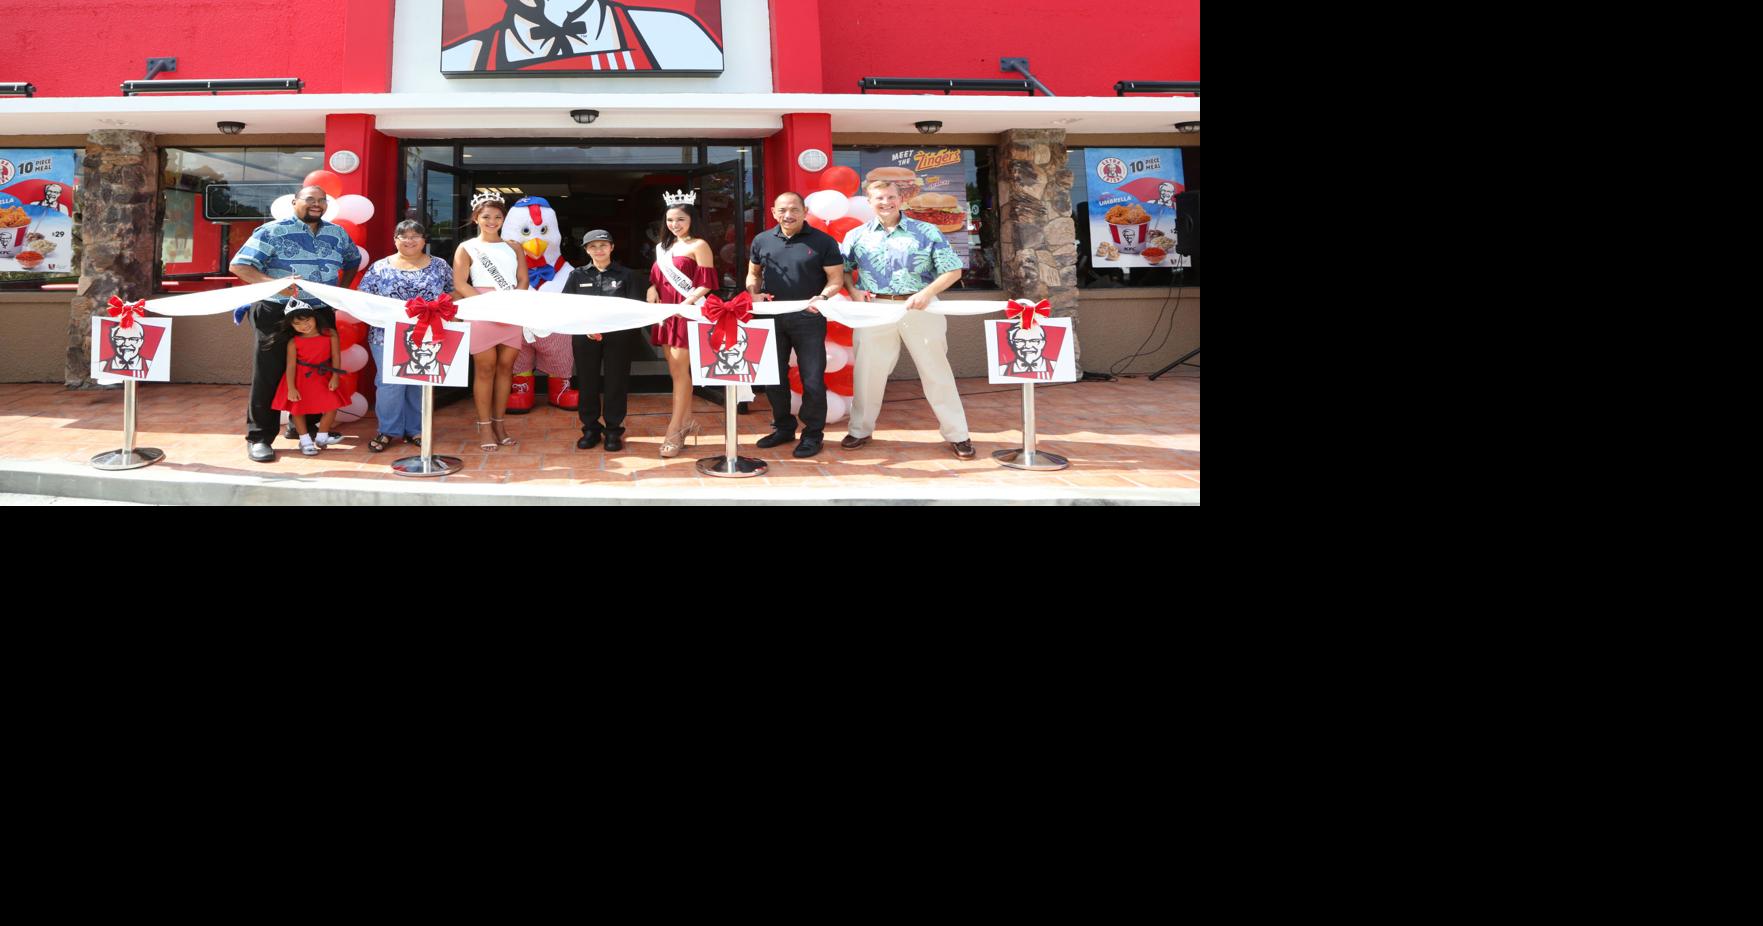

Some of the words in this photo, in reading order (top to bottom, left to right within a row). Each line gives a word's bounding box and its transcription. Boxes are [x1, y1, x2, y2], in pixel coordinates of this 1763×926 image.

[892, 150, 914, 161] MEET
[914, 149, 961, 171] Zingers
[1145, 157, 1160, 165] PIECE
[35, 158, 51, 166] PIECE
[898, 158, 911, 166] THE
[1129, 160, 1144, 173] 10
[17, 161, 33, 175] 10
[34, 164, 52, 172] MEAL
[1099, 196, 1132, 206] UMBRELLA
[480, 255, 493, 268] MISS
[486, 263, 509, 288] UNIVERSE
